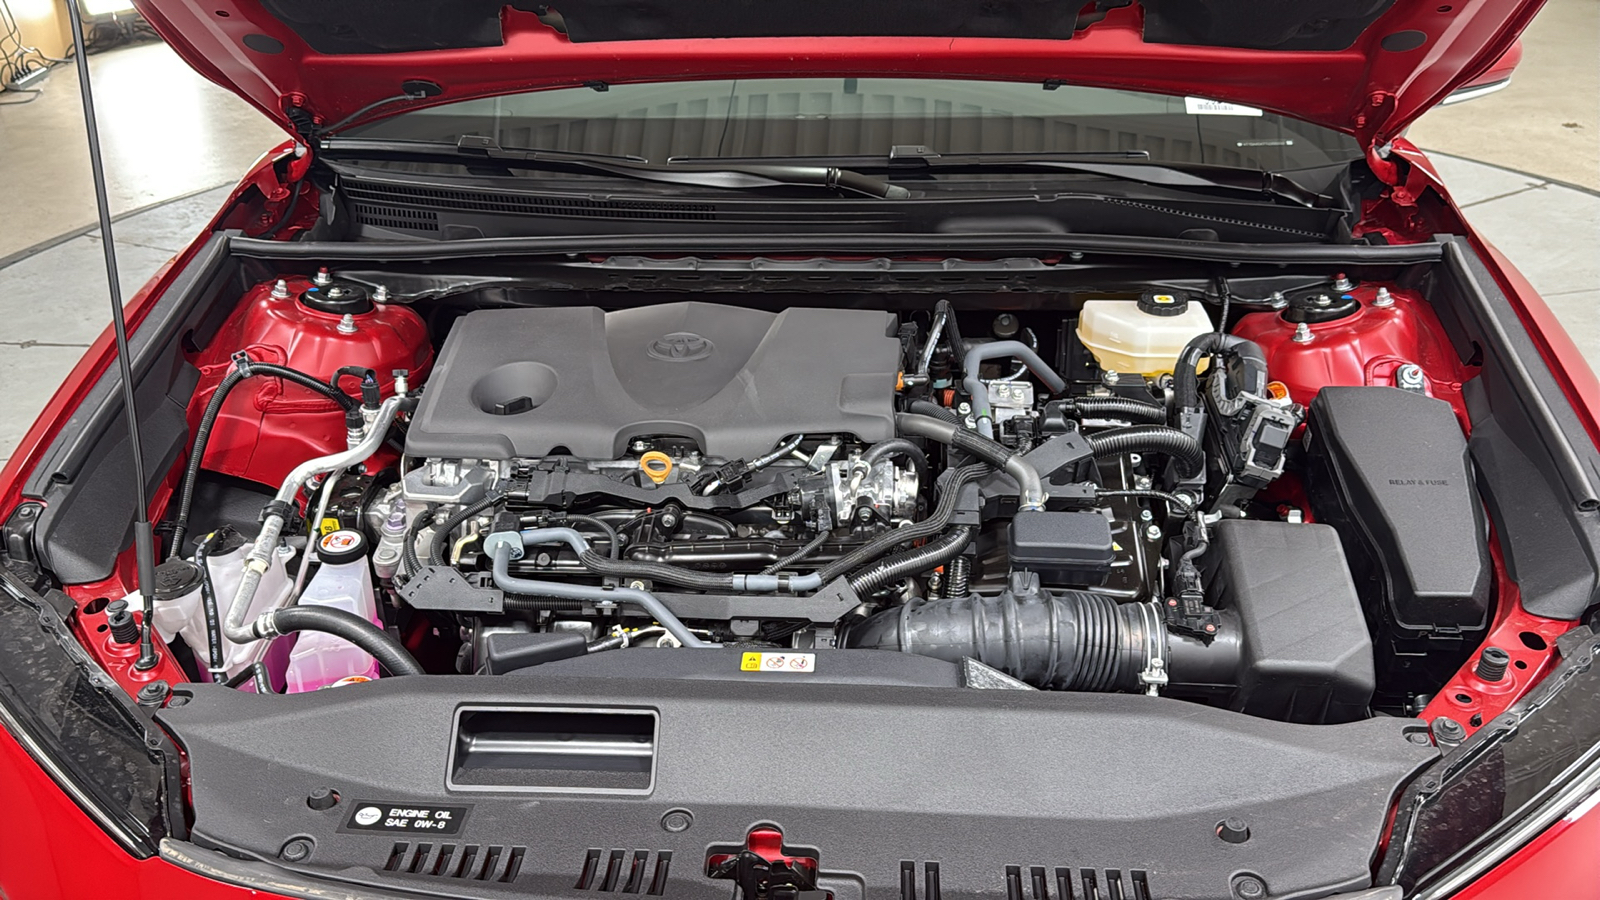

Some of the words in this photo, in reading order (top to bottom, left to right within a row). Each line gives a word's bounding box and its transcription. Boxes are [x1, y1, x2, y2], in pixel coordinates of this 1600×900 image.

[389, 808, 430, 818] ENGINE
[434, 810, 452, 819] OIL
[384, 818, 408, 827] SAE
[414, 820, 446, 829] 0W-8
